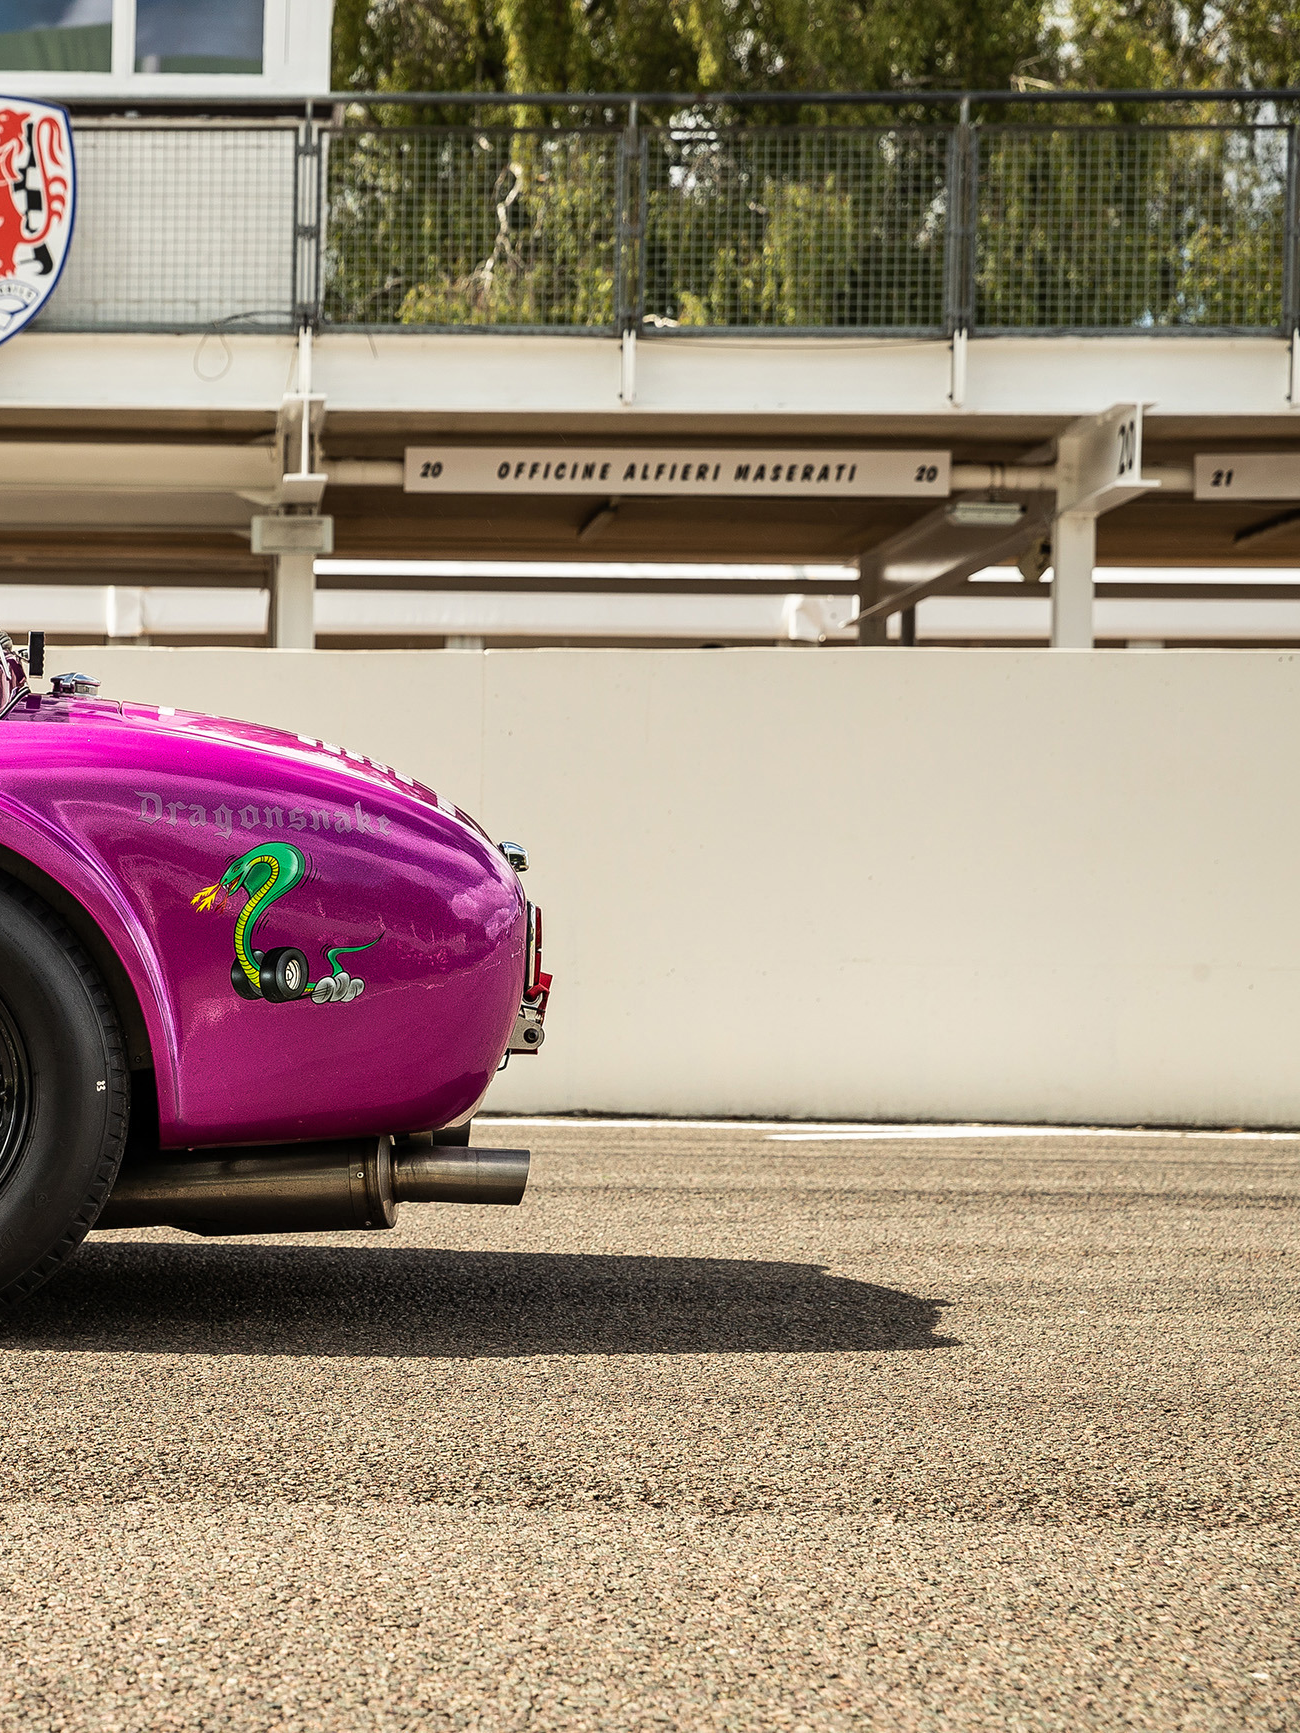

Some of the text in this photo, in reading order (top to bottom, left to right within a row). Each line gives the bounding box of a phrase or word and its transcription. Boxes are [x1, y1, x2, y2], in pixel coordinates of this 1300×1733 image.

[1118, 420, 1135, 475] 20
[420, 461, 938, 483] 20 OFFICINE ALFIERI MASERATI 20
[1211, 469, 1234, 487] 21
[134, 790, 393, 840] Dragonsnake
